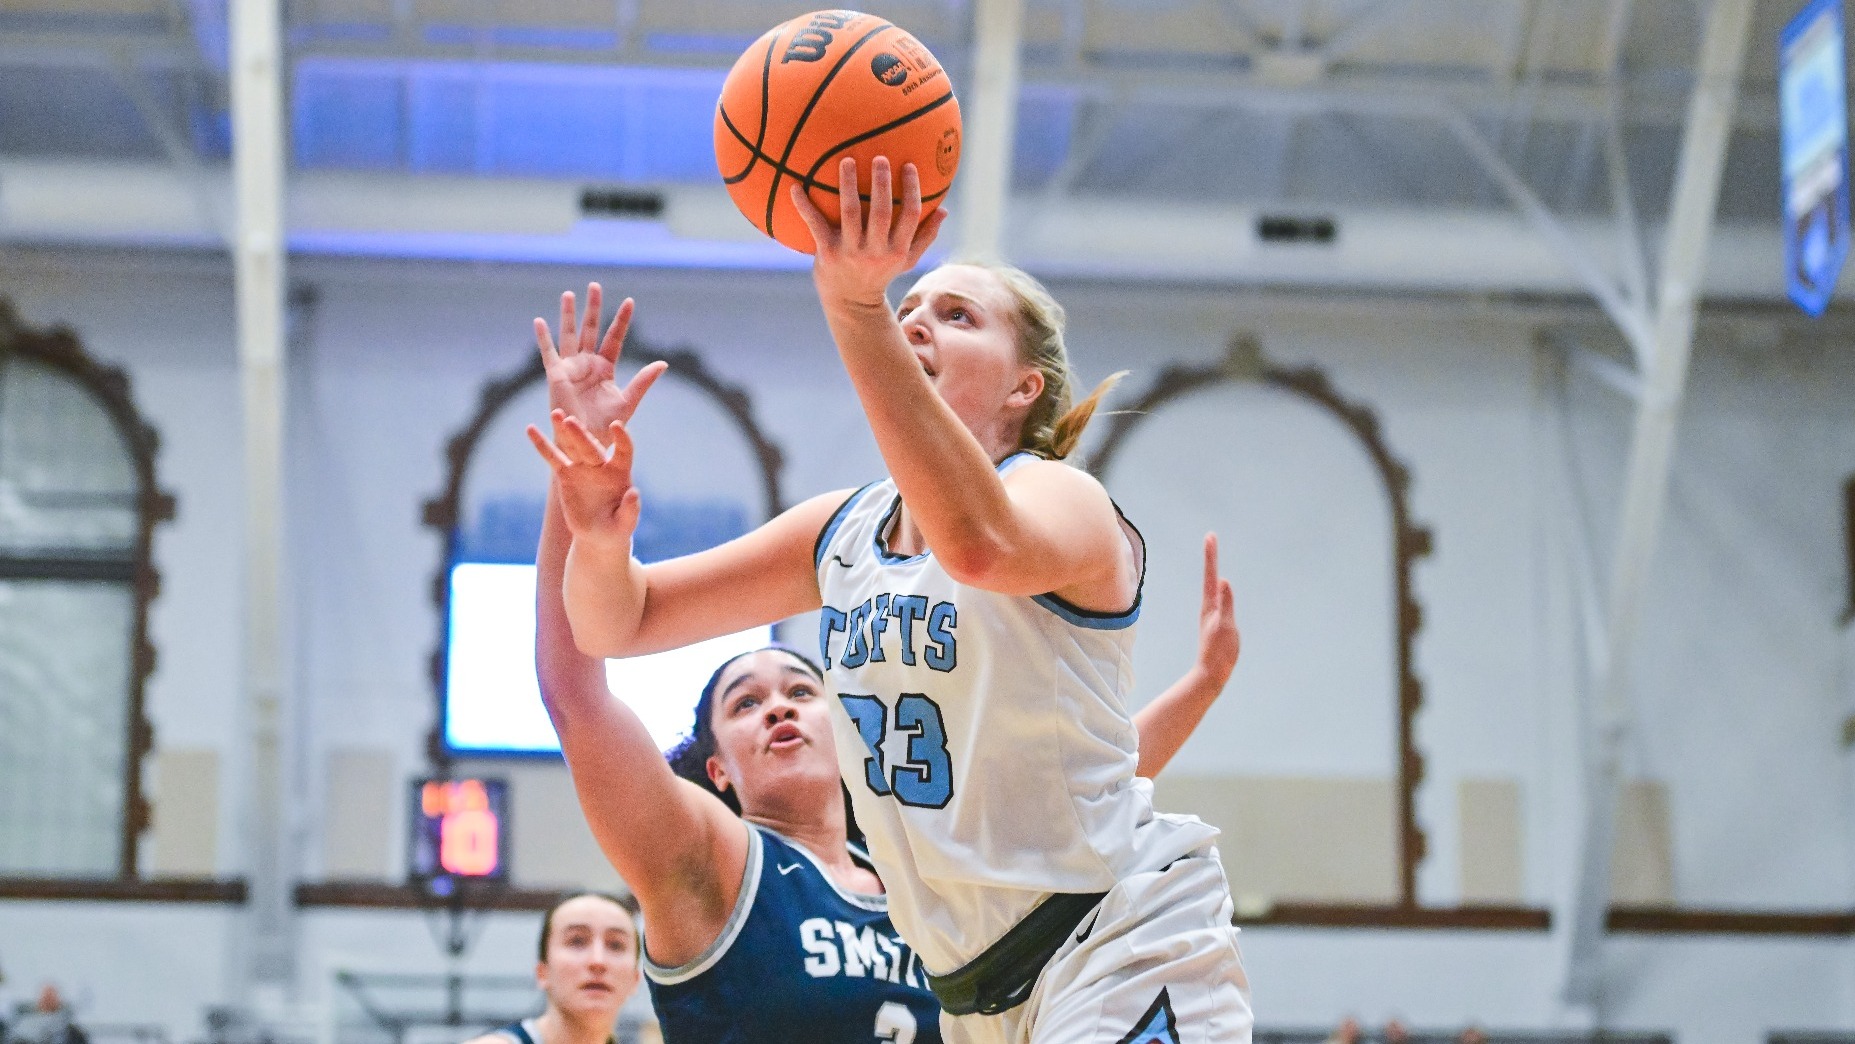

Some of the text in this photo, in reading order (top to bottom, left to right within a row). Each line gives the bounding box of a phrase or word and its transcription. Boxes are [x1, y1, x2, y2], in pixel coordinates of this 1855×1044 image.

[819, 592, 957, 674] TUFTS
[837, 692, 954, 810] 33
[799, 916, 933, 992] SMIT
